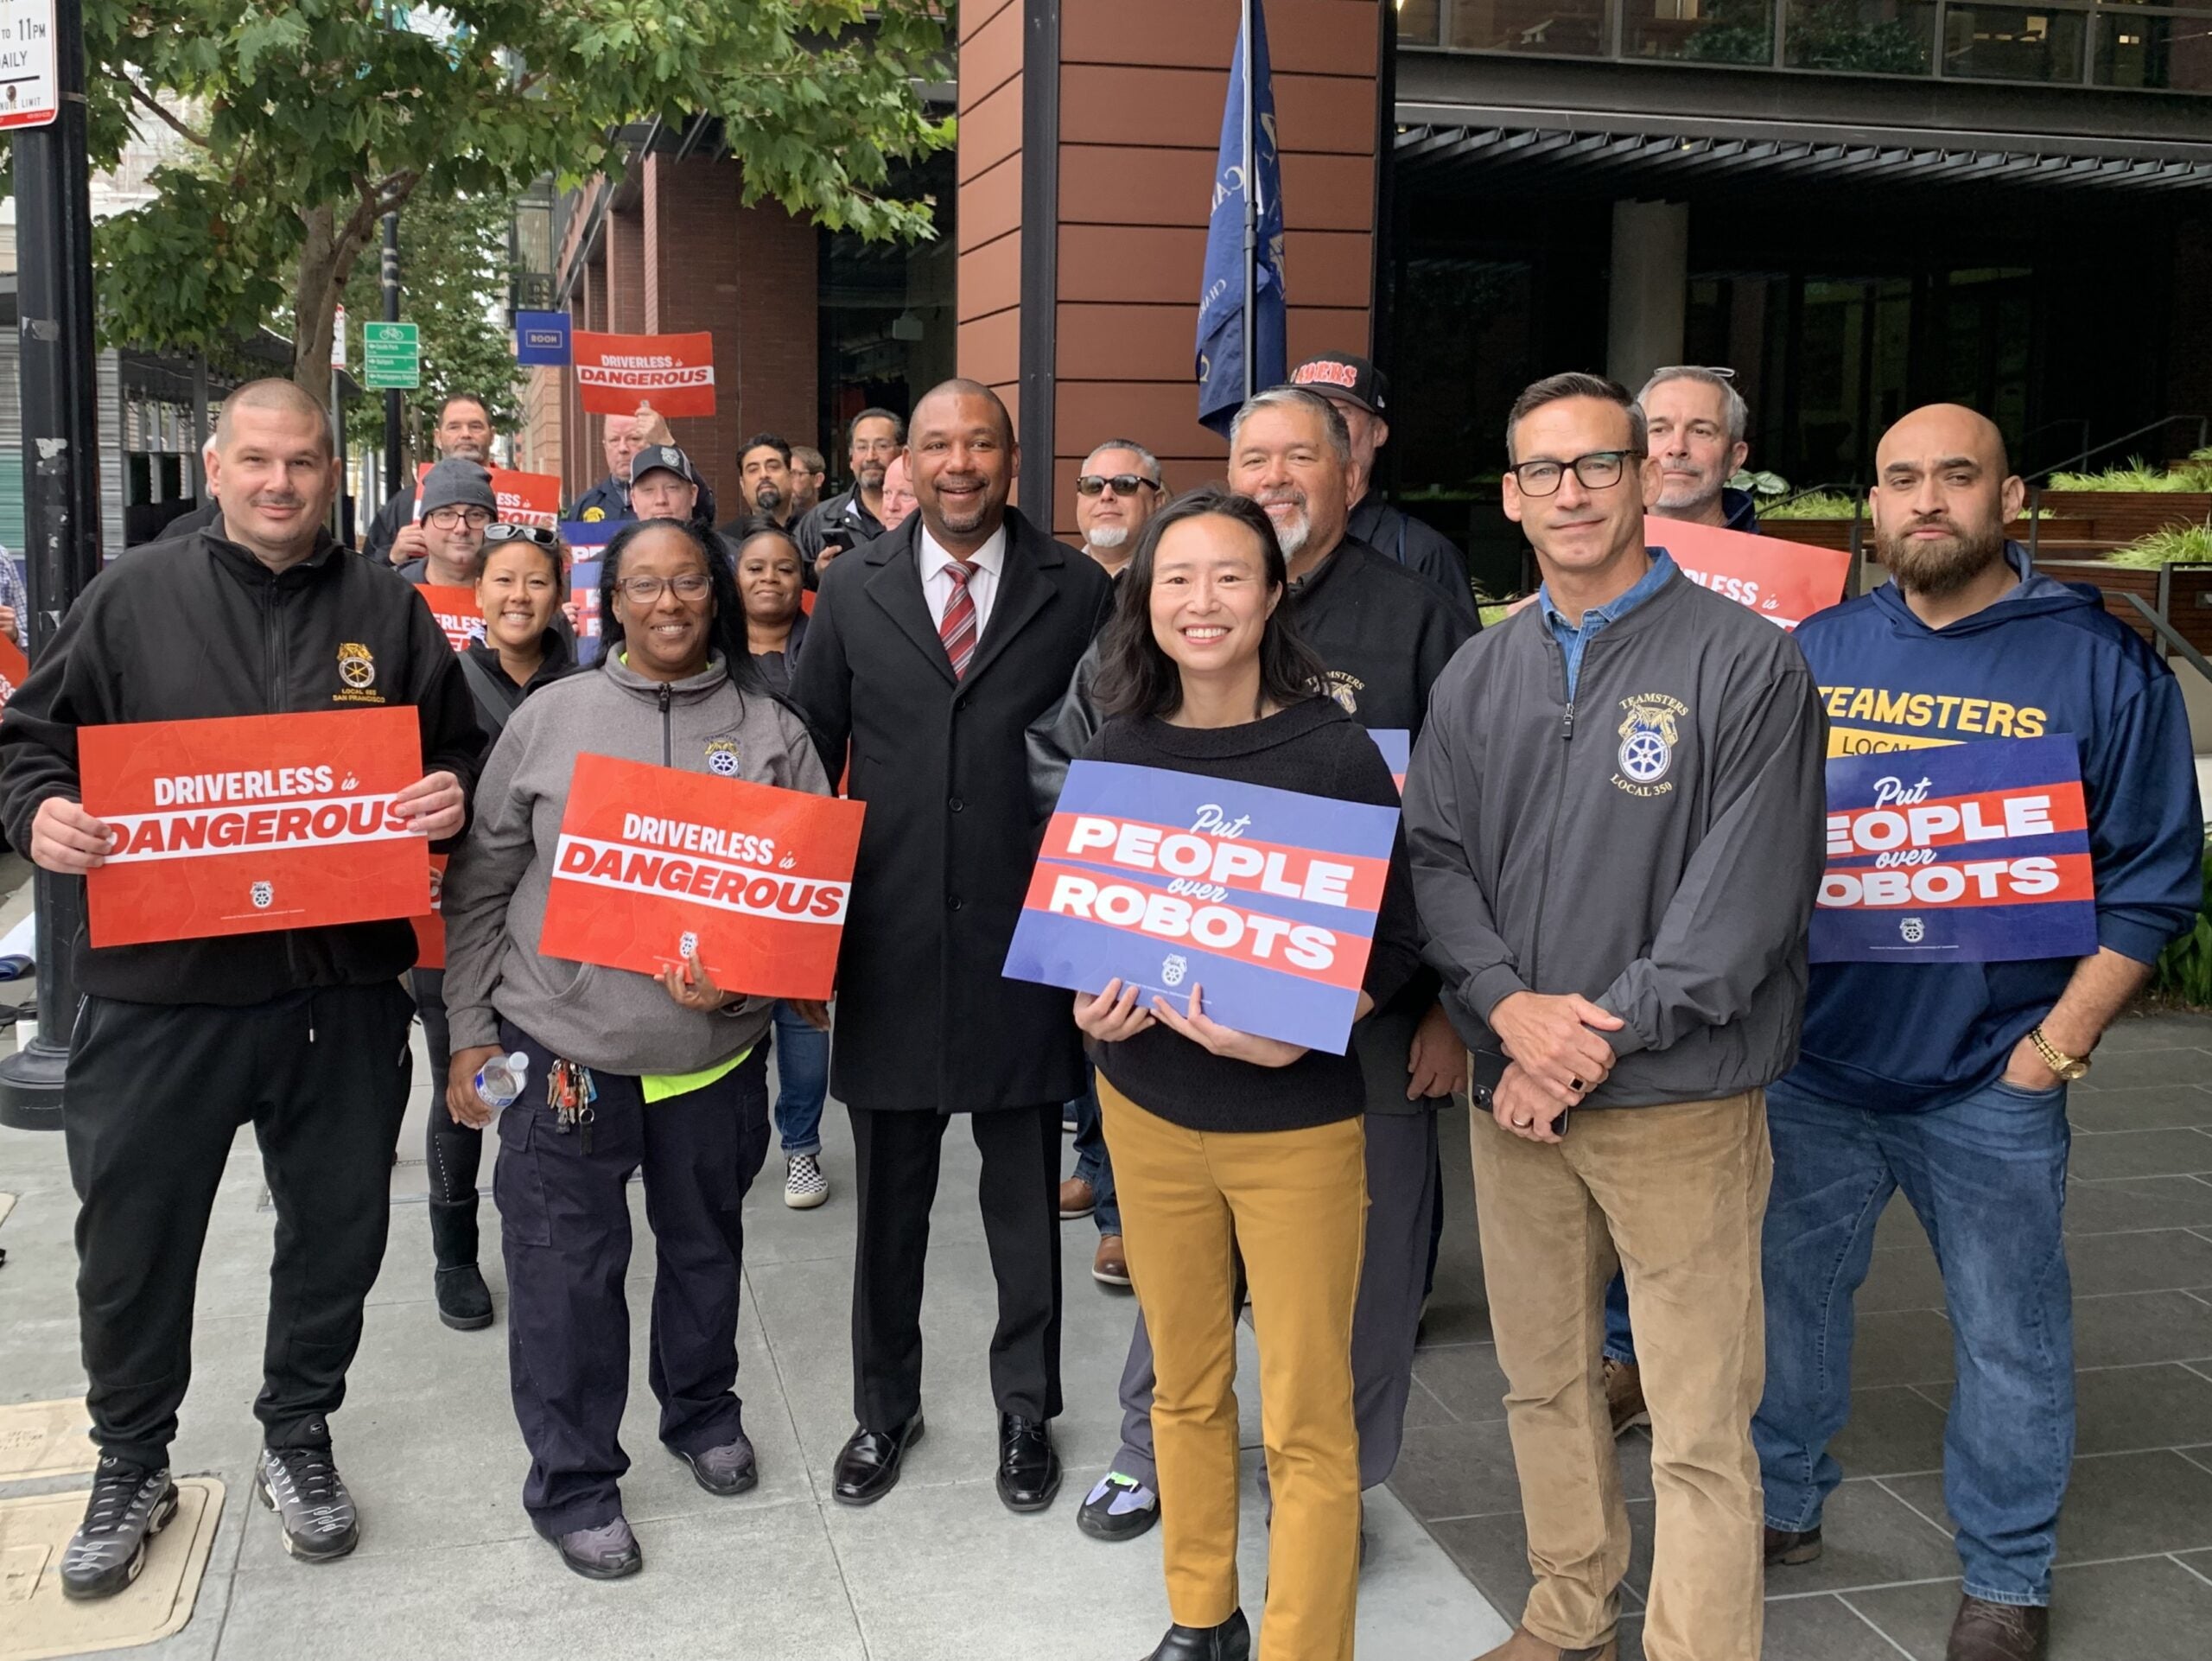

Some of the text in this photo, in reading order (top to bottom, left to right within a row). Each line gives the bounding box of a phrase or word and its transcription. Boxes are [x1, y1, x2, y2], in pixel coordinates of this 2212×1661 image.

[2, 17, 46, 41] TO 11PM
[0, 50, 28, 69] AILY
[22, 97, 41, 108] LIMIT
[600, 354, 672, 369] DRIVERLESS
[580, 368, 708, 386] DANGEROUS
[1762, 593, 1780, 610] is
[1618, 693, 1689, 716] TEAMSTERS
[154, 765, 359, 806] DRIVERLESS is
[1610, 773, 1673, 797] LOCAL 350
[1873, 776, 1933, 811] Put
[1189, 803, 1251, 839] Put
[622, 812, 797, 870] DRIVERLESS is
[1065, 816, 1354, 908] PEOPLE
[1875, 848, 1937, 869] over
[558, 842, 844, 918] DANGEROUS
[1166, 875, 1229, 904] over
[1815, 856, 2060, 907] OBOTS
[1047, 874, 1338, 971] ROBOTS
